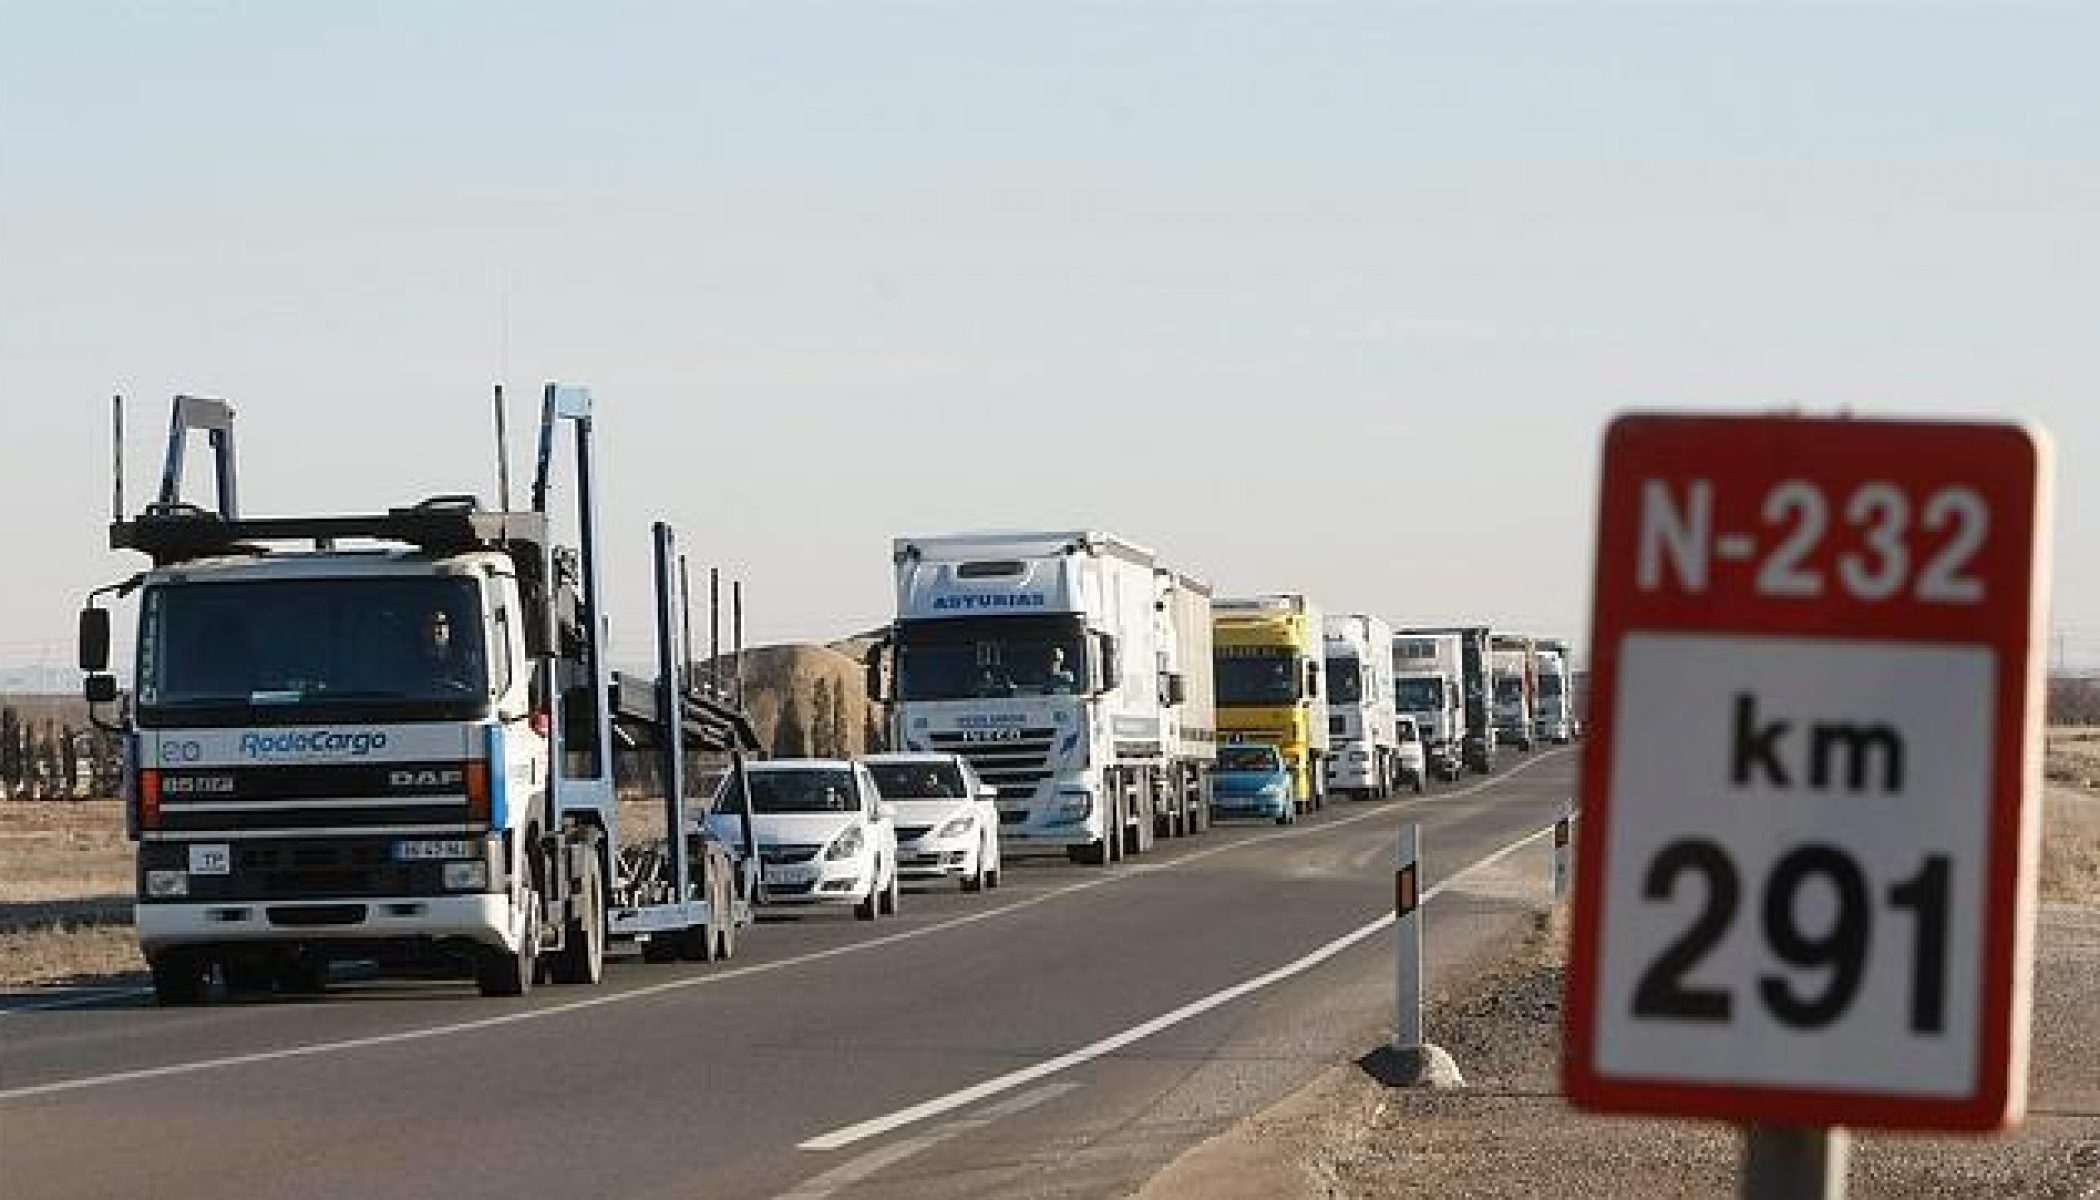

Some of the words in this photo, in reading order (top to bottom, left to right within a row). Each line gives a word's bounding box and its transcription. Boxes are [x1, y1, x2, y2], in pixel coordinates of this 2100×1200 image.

[1636, 478, 1990, 602] N-232
[933, 592, 1044, 609] ASTURIAS
[390, 770, 462, 787] DAF
[1728, 690, 1906, 795] km
[1628, 836, 1956, 1036] 291
